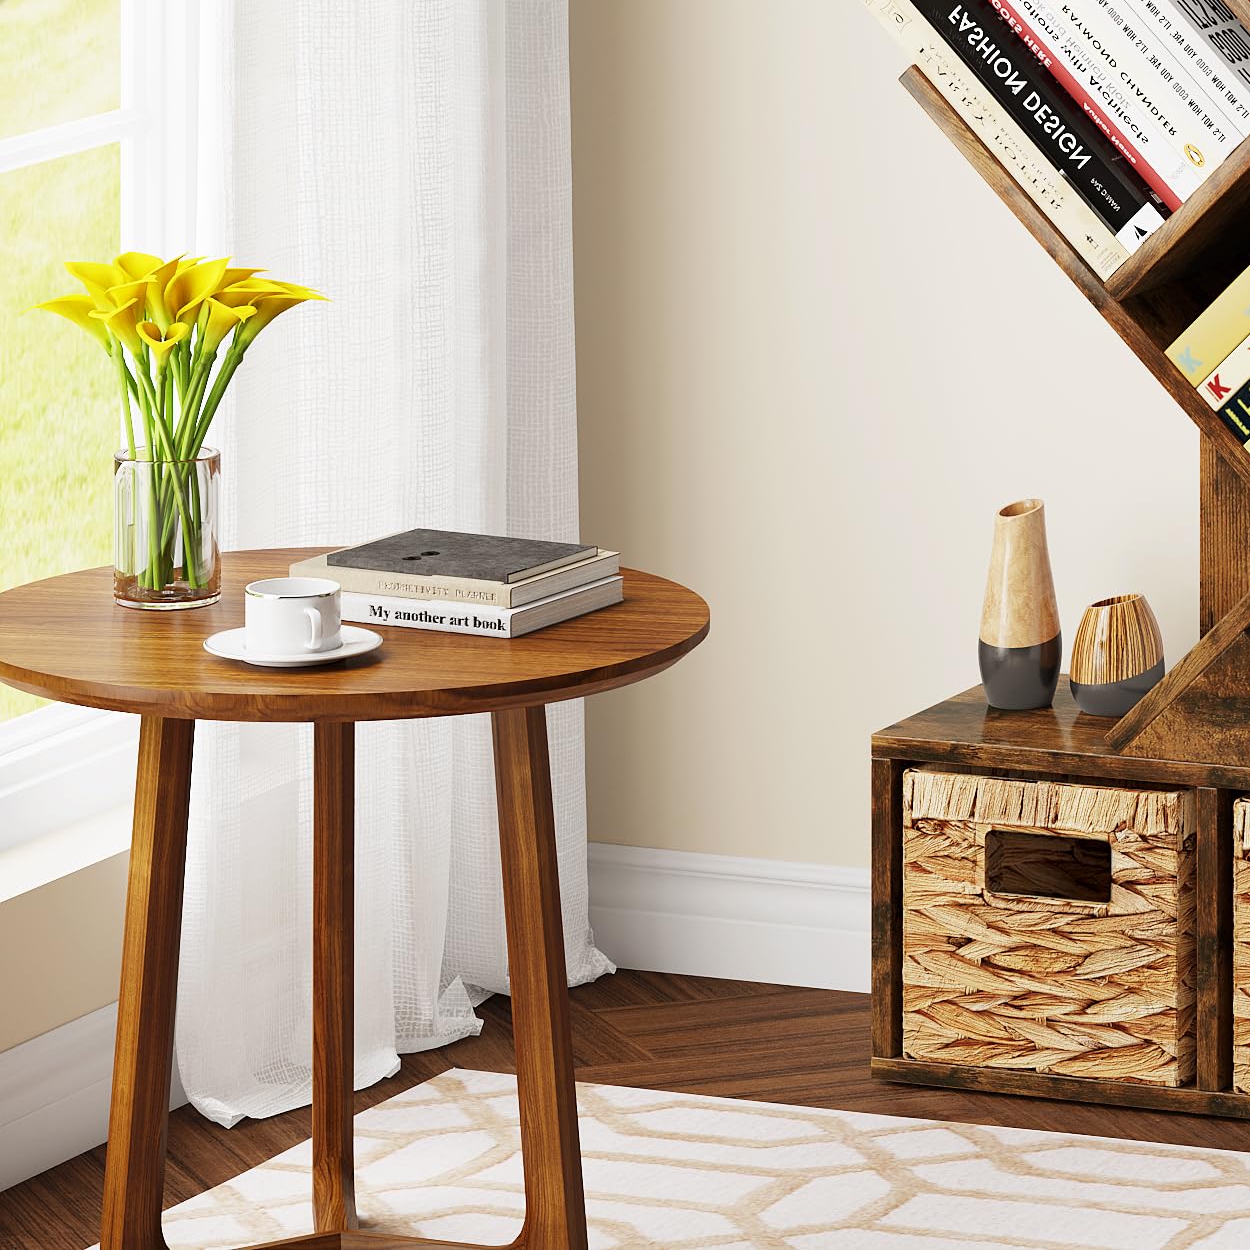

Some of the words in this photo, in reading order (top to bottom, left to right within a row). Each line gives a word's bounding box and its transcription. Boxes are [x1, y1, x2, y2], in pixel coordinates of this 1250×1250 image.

[369, 605, 391, 621] My
[395, 611, 446, 625] another
[449, 615, 470, 627] art
[473, 616, 507, 631] book
